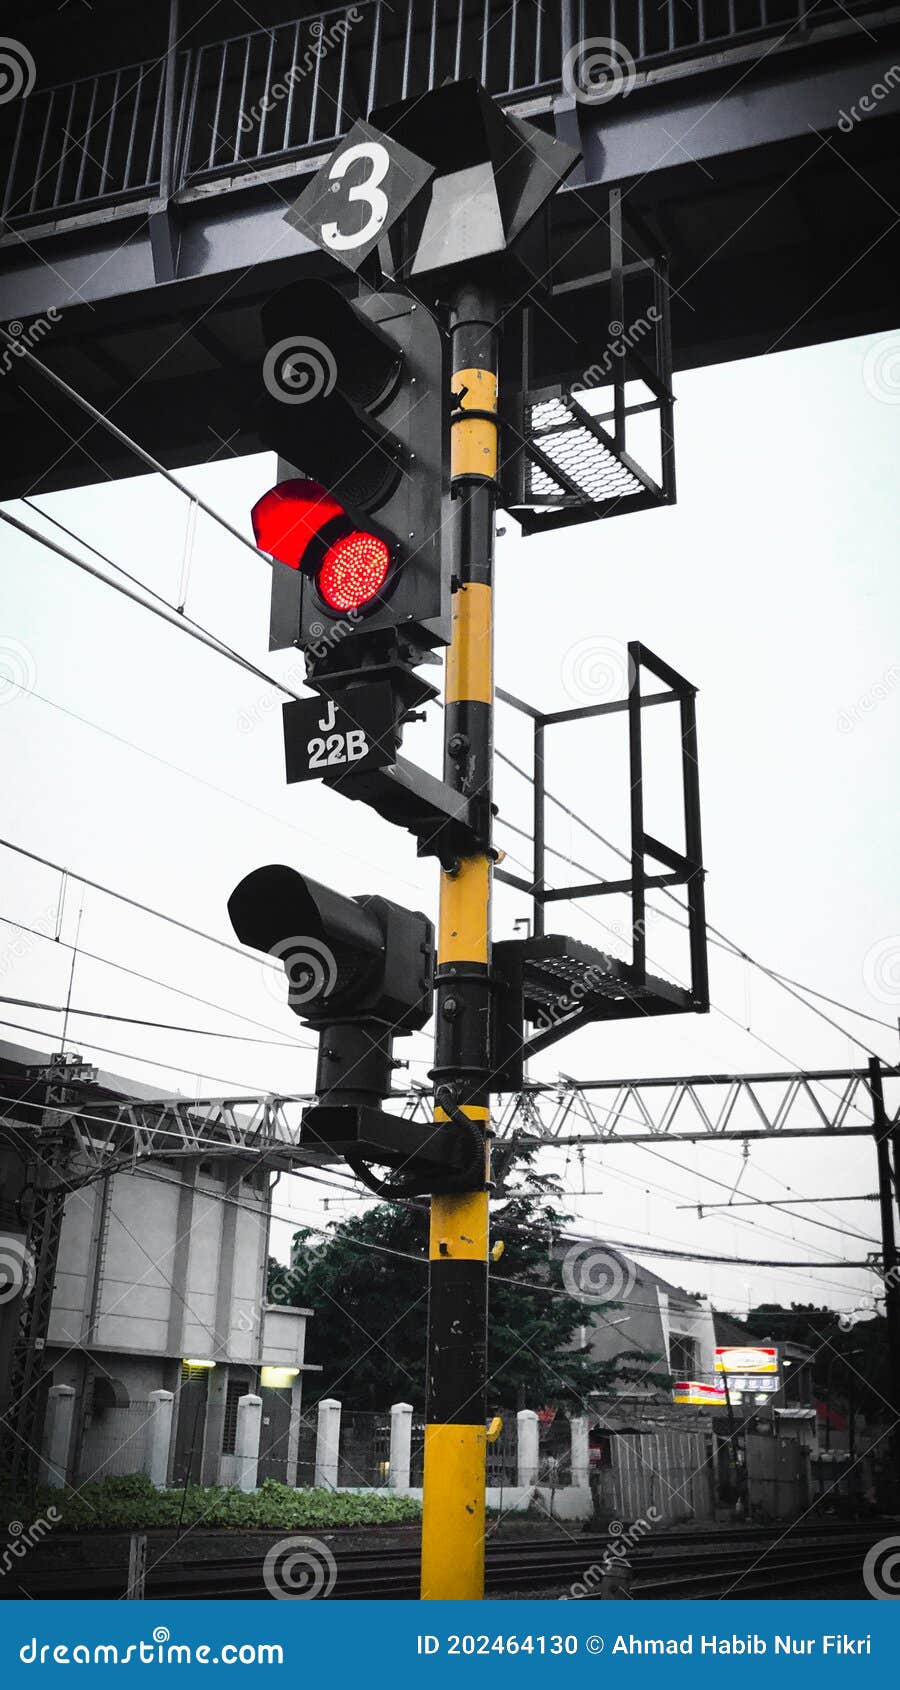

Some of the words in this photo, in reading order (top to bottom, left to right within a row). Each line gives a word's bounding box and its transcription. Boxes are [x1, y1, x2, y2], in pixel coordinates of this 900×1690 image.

[321, 142, 390, 251] 3
[318, 700, 336, 732] J
[307, 730, 369, 769] 22B
